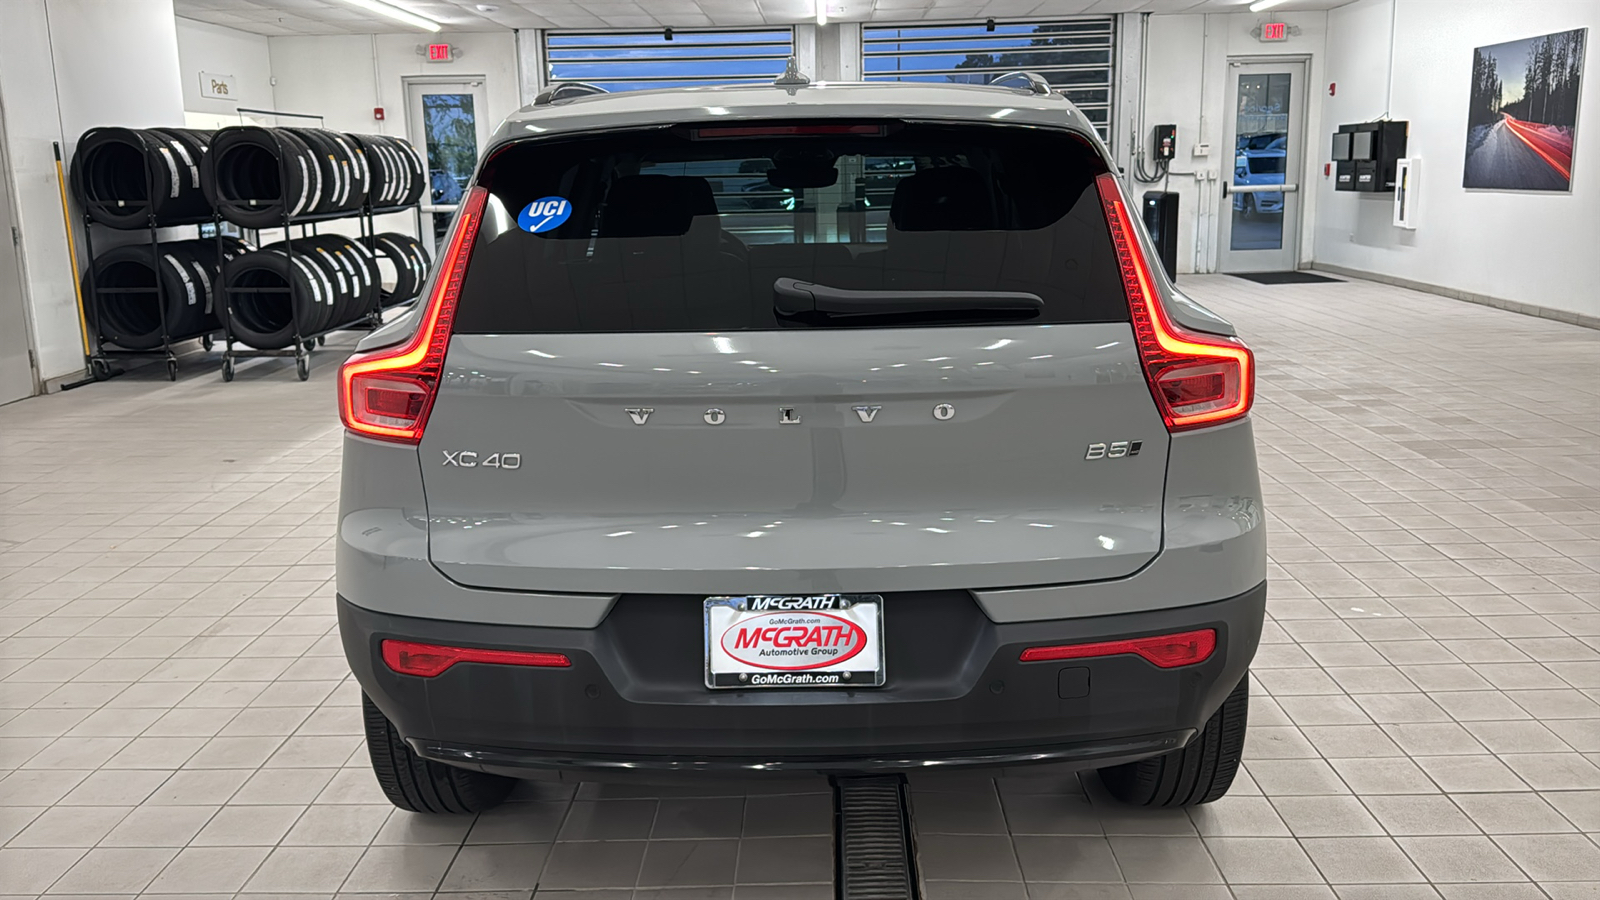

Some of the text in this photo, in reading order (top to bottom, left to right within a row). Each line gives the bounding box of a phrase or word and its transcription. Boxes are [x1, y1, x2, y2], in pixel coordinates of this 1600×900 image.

[1265, 23, 1285, 39] EXIT
[429, 44, 449, 60] EXIT
[211, 79, 229, 95] Parts
[528, 200, 567, 217] UCI
[624, 403, 956, 425] VOLVO
[1085, 441, 1128, 460] B5
[758, 647, 839, 657] Automotive Group
[751, 674, 839, 685] GoMcGrath.com
